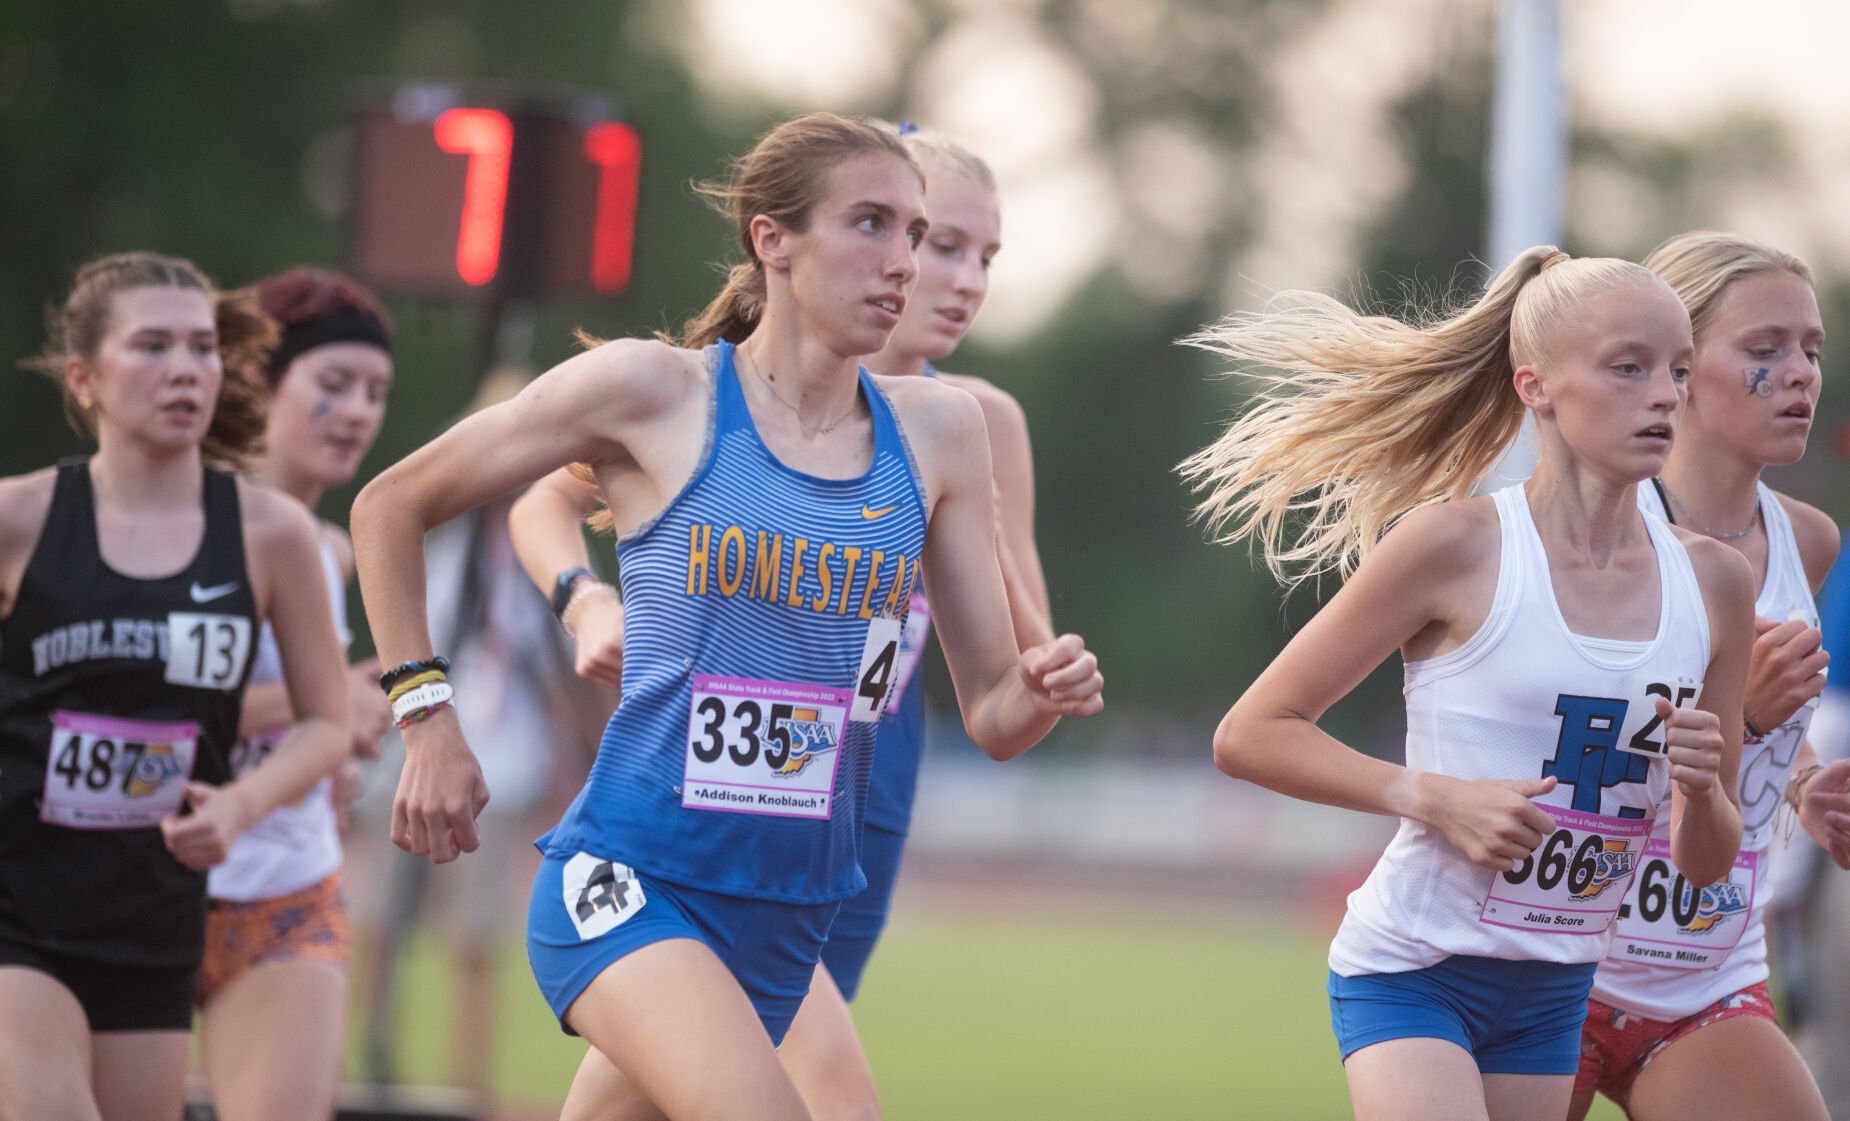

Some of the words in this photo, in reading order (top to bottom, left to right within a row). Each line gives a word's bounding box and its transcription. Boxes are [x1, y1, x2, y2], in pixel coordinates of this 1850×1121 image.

[433, 107, 514, 286] 7
[190, 621, 237, 683] 13
[858, 641, 898, 712] 4
[692, 696, 794, 770] 335
[55, 734, 146, 795] 487
[700, 788, 754, 804] Addison
[758, 793, 817, 808] Knoblauch
[1523, 911, 1551, 924] Julia
[1553, 915, 1584, 926] Score
[1617, 859, 1700, 927] 60
[1626, 944, 1673, 960] Savana
[1676, 950, 1709, 963] Miller
